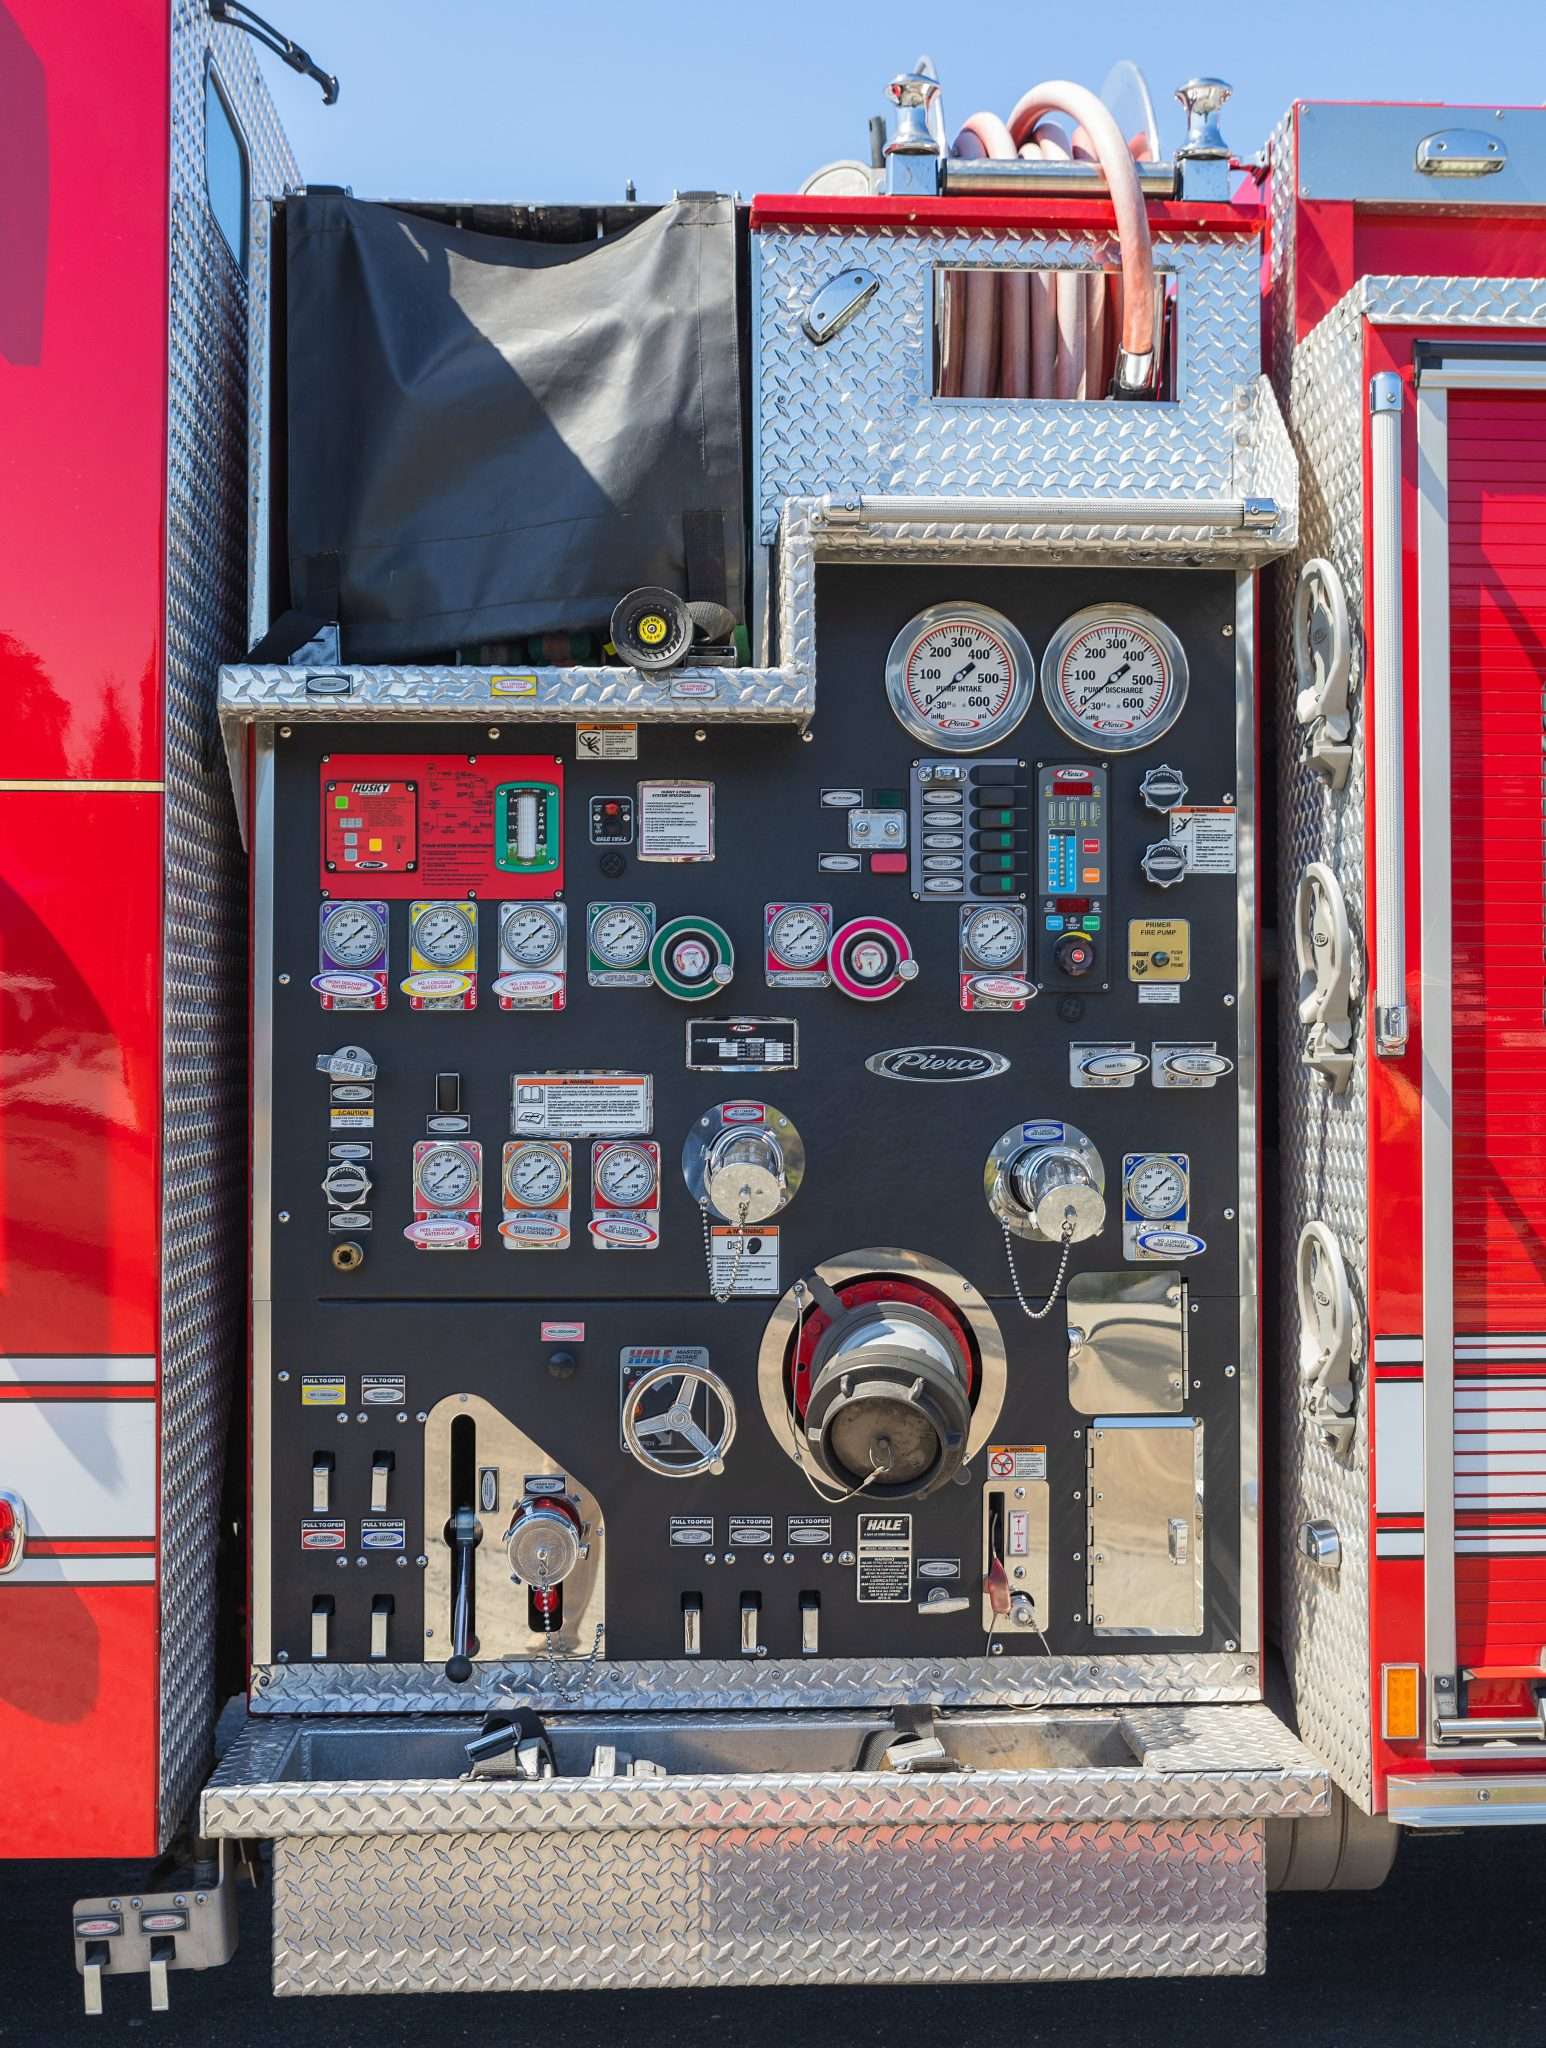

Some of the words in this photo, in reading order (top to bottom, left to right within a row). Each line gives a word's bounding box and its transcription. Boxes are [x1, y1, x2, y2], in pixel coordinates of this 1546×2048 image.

[951, 637, 972, 648] 300
[1105, 639, 1127, 649] 300
[930, 647, 951, 658] 200
[968, 649, 990, 660] 400
[1085, 648, 1106, 659] 200
[1122, 651, 1144, 661] 400
[920, 669, 941, 679] 100
[977, 673, 999, 684] 500
[1074, 670, 1096, 680] 100
[1132, 675, 1153, 685] 500
[1105, 686, 1143, 694] DISCHARGE
[968, 697, 990, 707] 600
[1122, 698, 1144, 709] 600
[351, 783, 391, 793] HUSKY
[890, 1052, 986, 1072] Pierce
[866, 1519, 903, 1531] HALE
